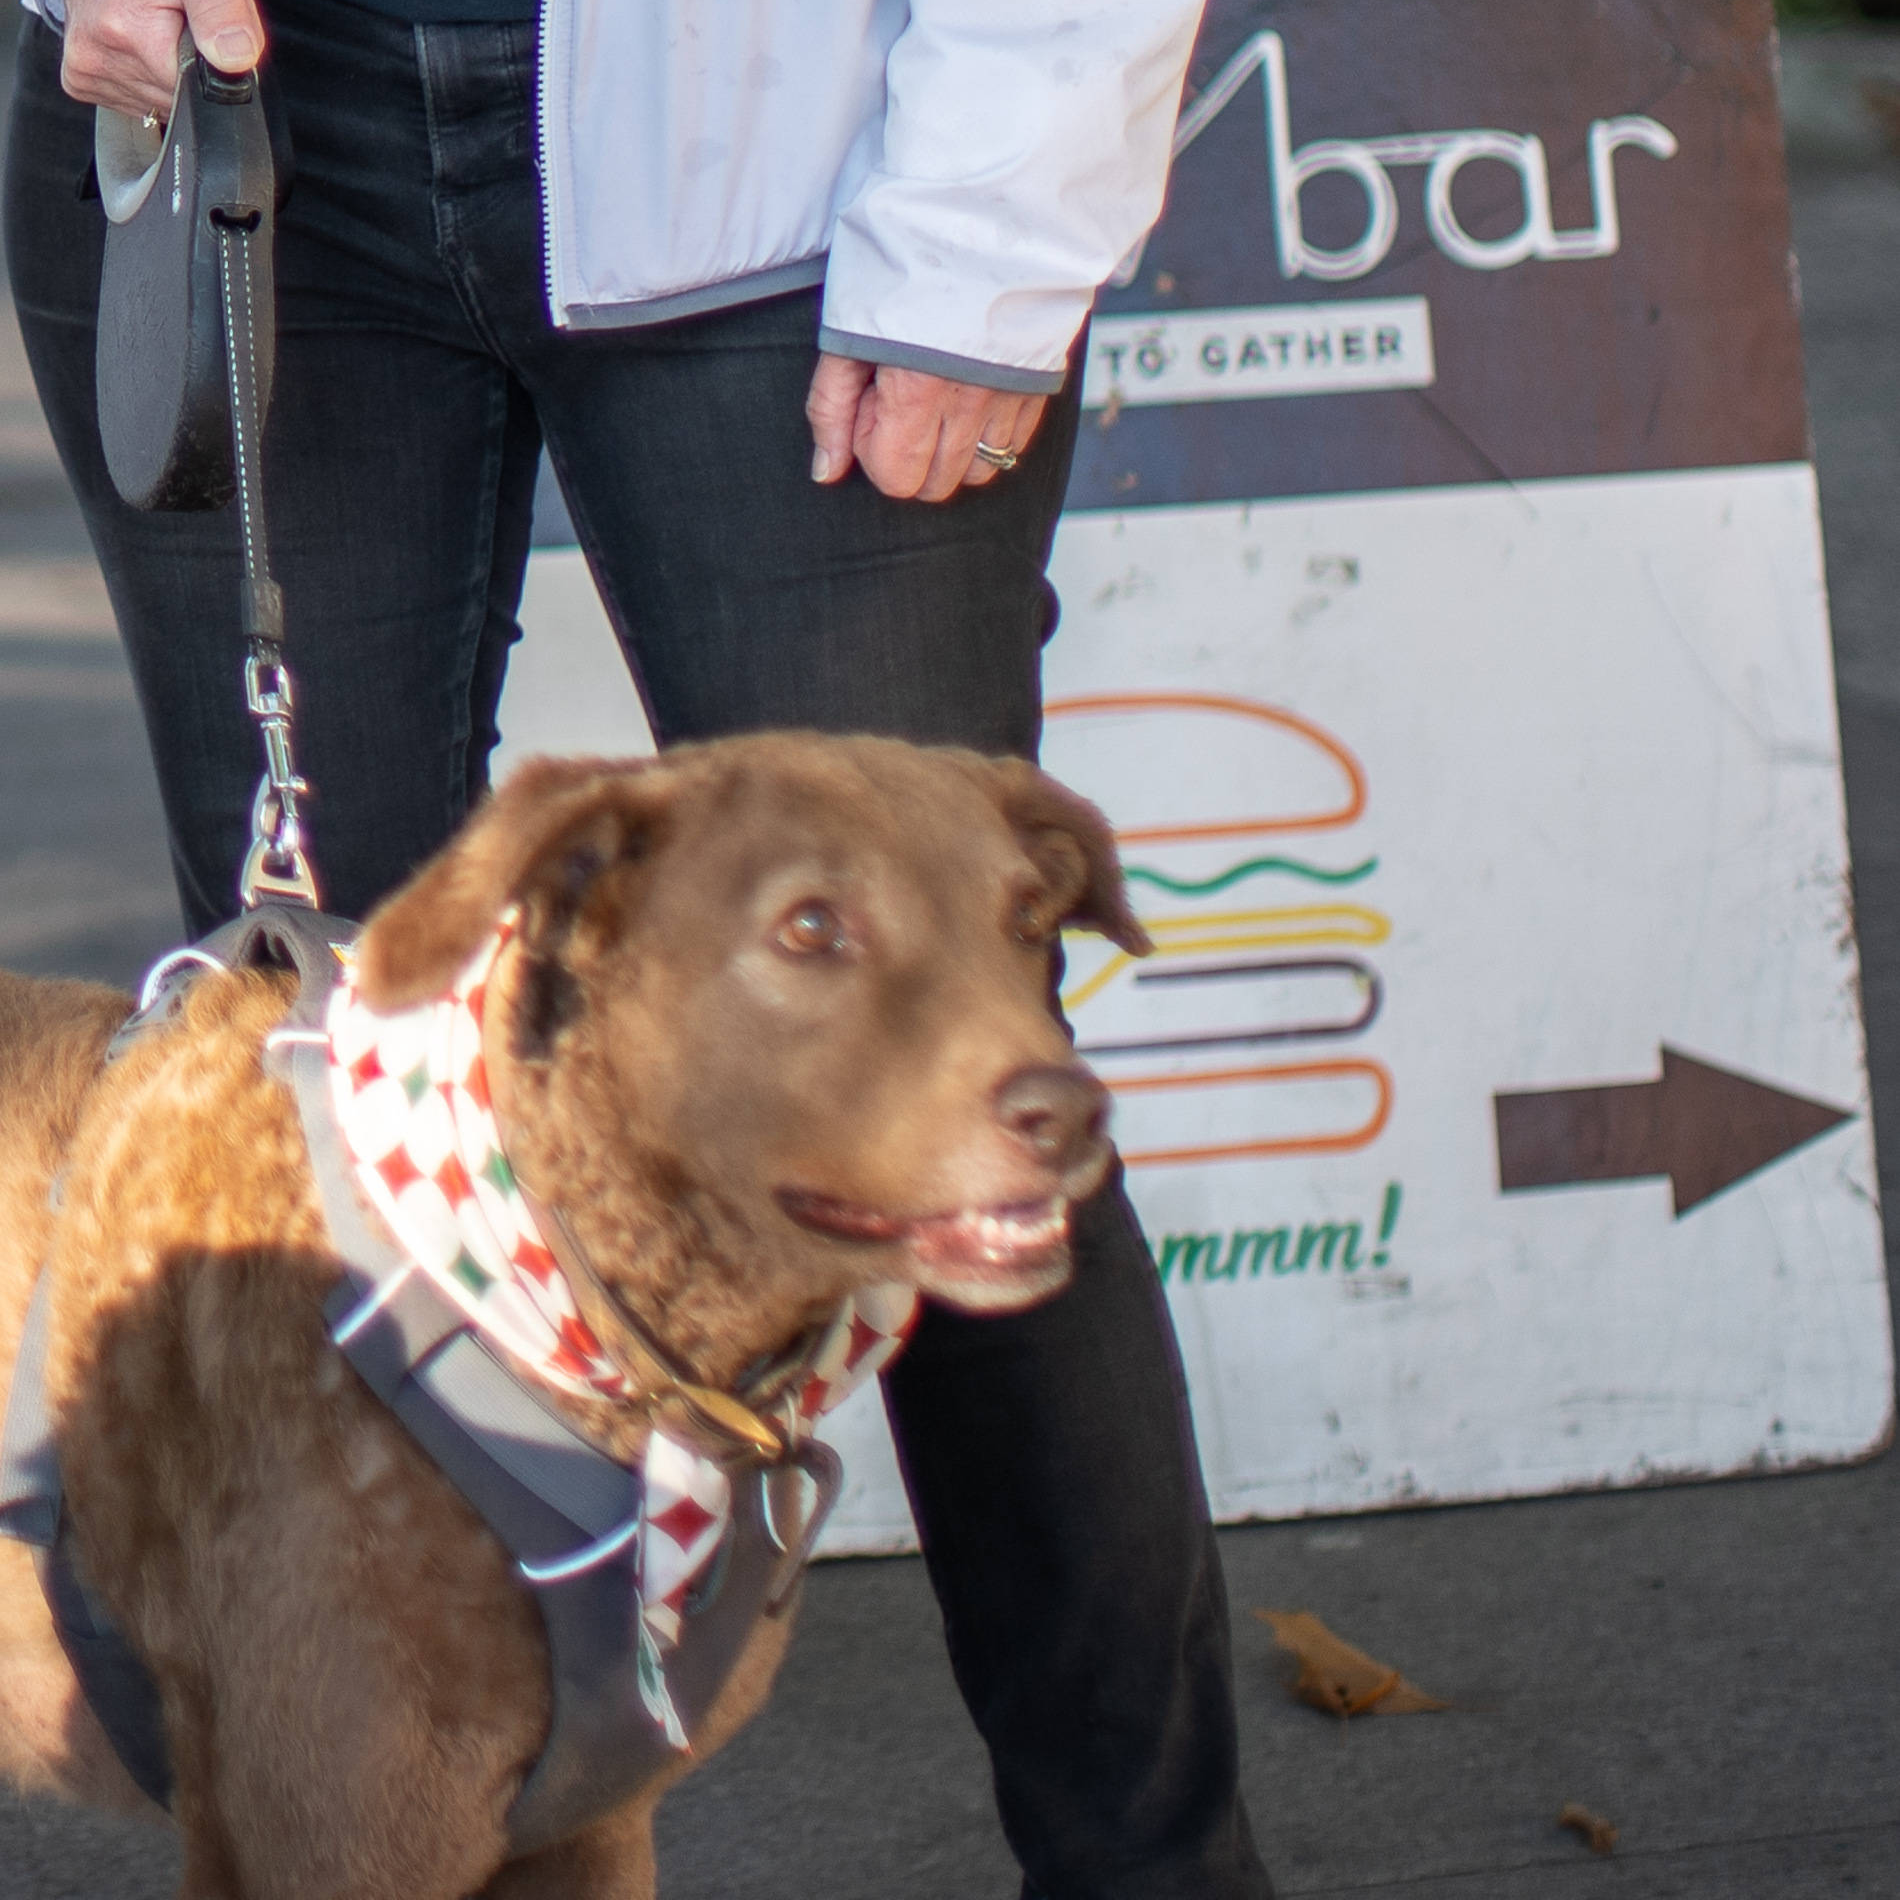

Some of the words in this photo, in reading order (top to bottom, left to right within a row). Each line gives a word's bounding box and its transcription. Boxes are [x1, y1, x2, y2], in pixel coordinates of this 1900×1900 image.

[1172, 29, 1678, 280] bar
[1098, 341, 1166, 379] TO
[1200, 326, 1402, 374] GATHER
[1148, 1179, 1404, 1286] mmm!
